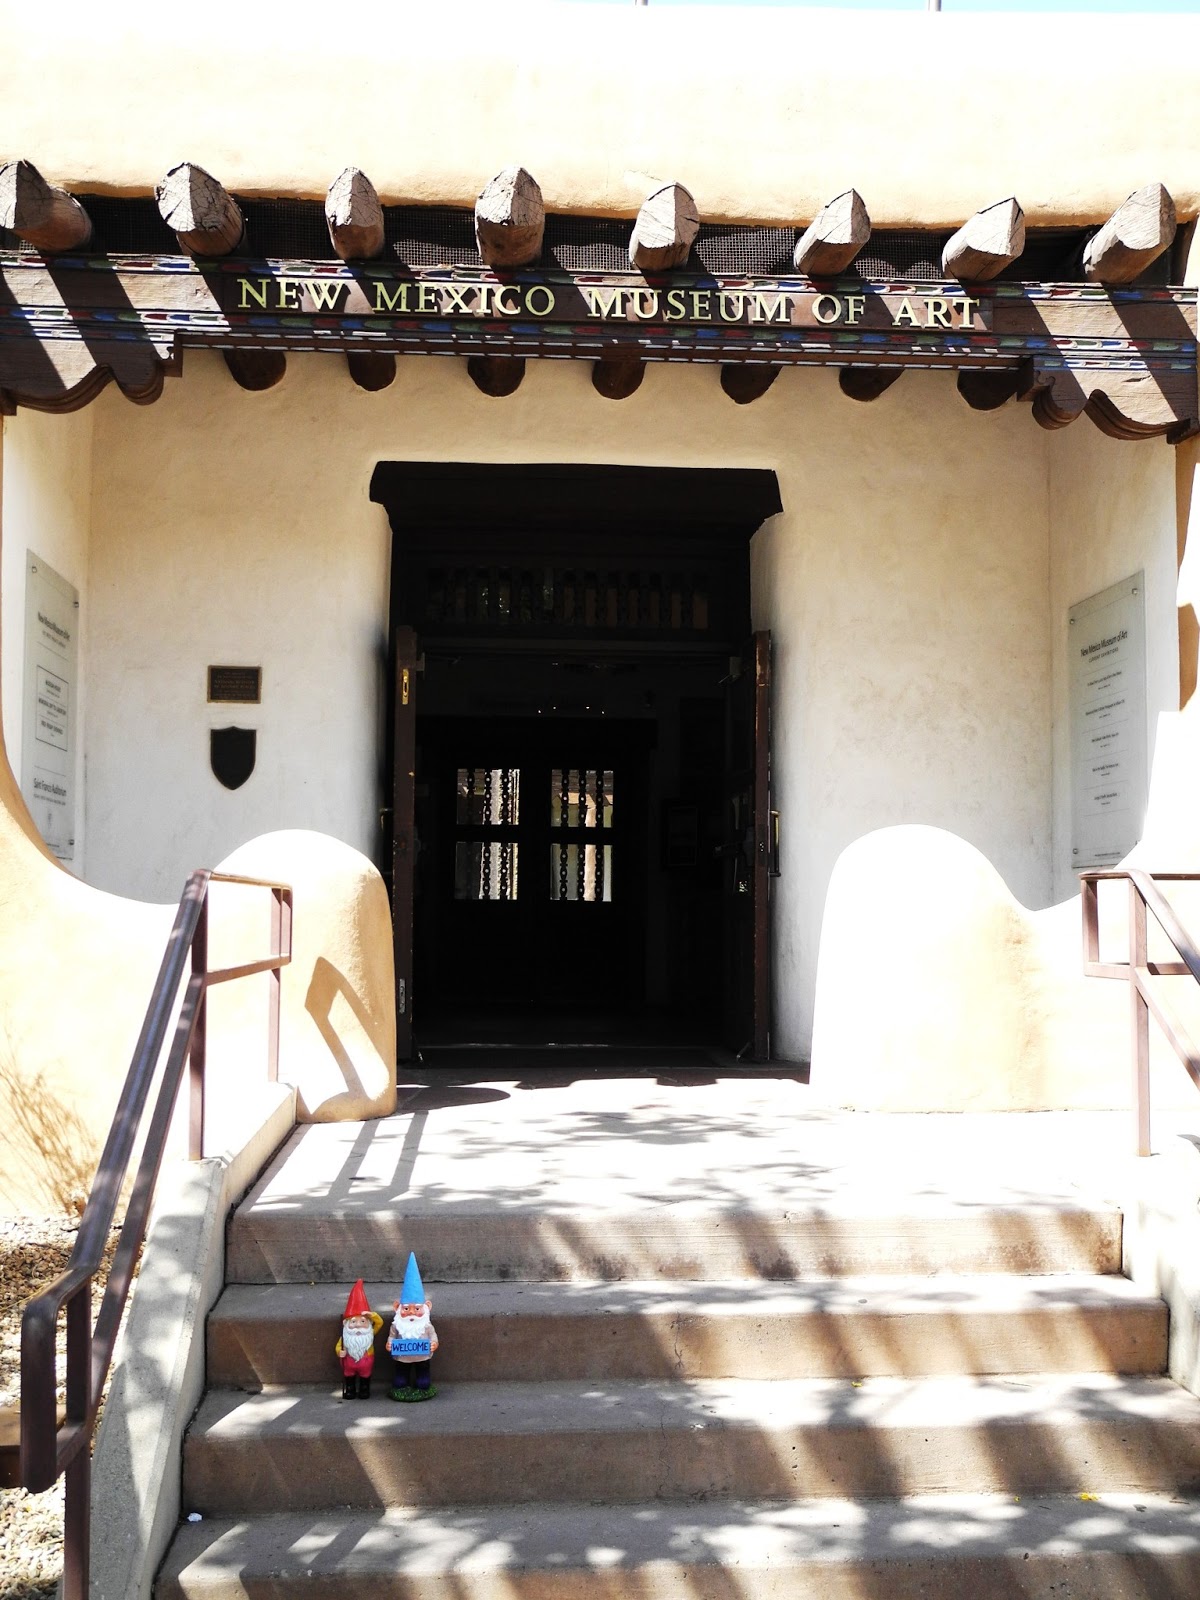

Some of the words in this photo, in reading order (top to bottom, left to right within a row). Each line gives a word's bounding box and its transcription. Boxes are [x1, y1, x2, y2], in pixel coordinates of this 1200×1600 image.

[237, 278, 346, 310] NEW
[372, 281, 555, 316] MEXICO
[587, 288, 791, 322] MUSEUM
[812, 294, 866, 325] OF
[891, 297, 980, 328] ART
[1080, 648, 1089, 657] New
[1089, 644, 1101, 653] Mexico
[1101, 636, 1117, 648] Museum
[392, 1341, 429, 1352] WELCOME
